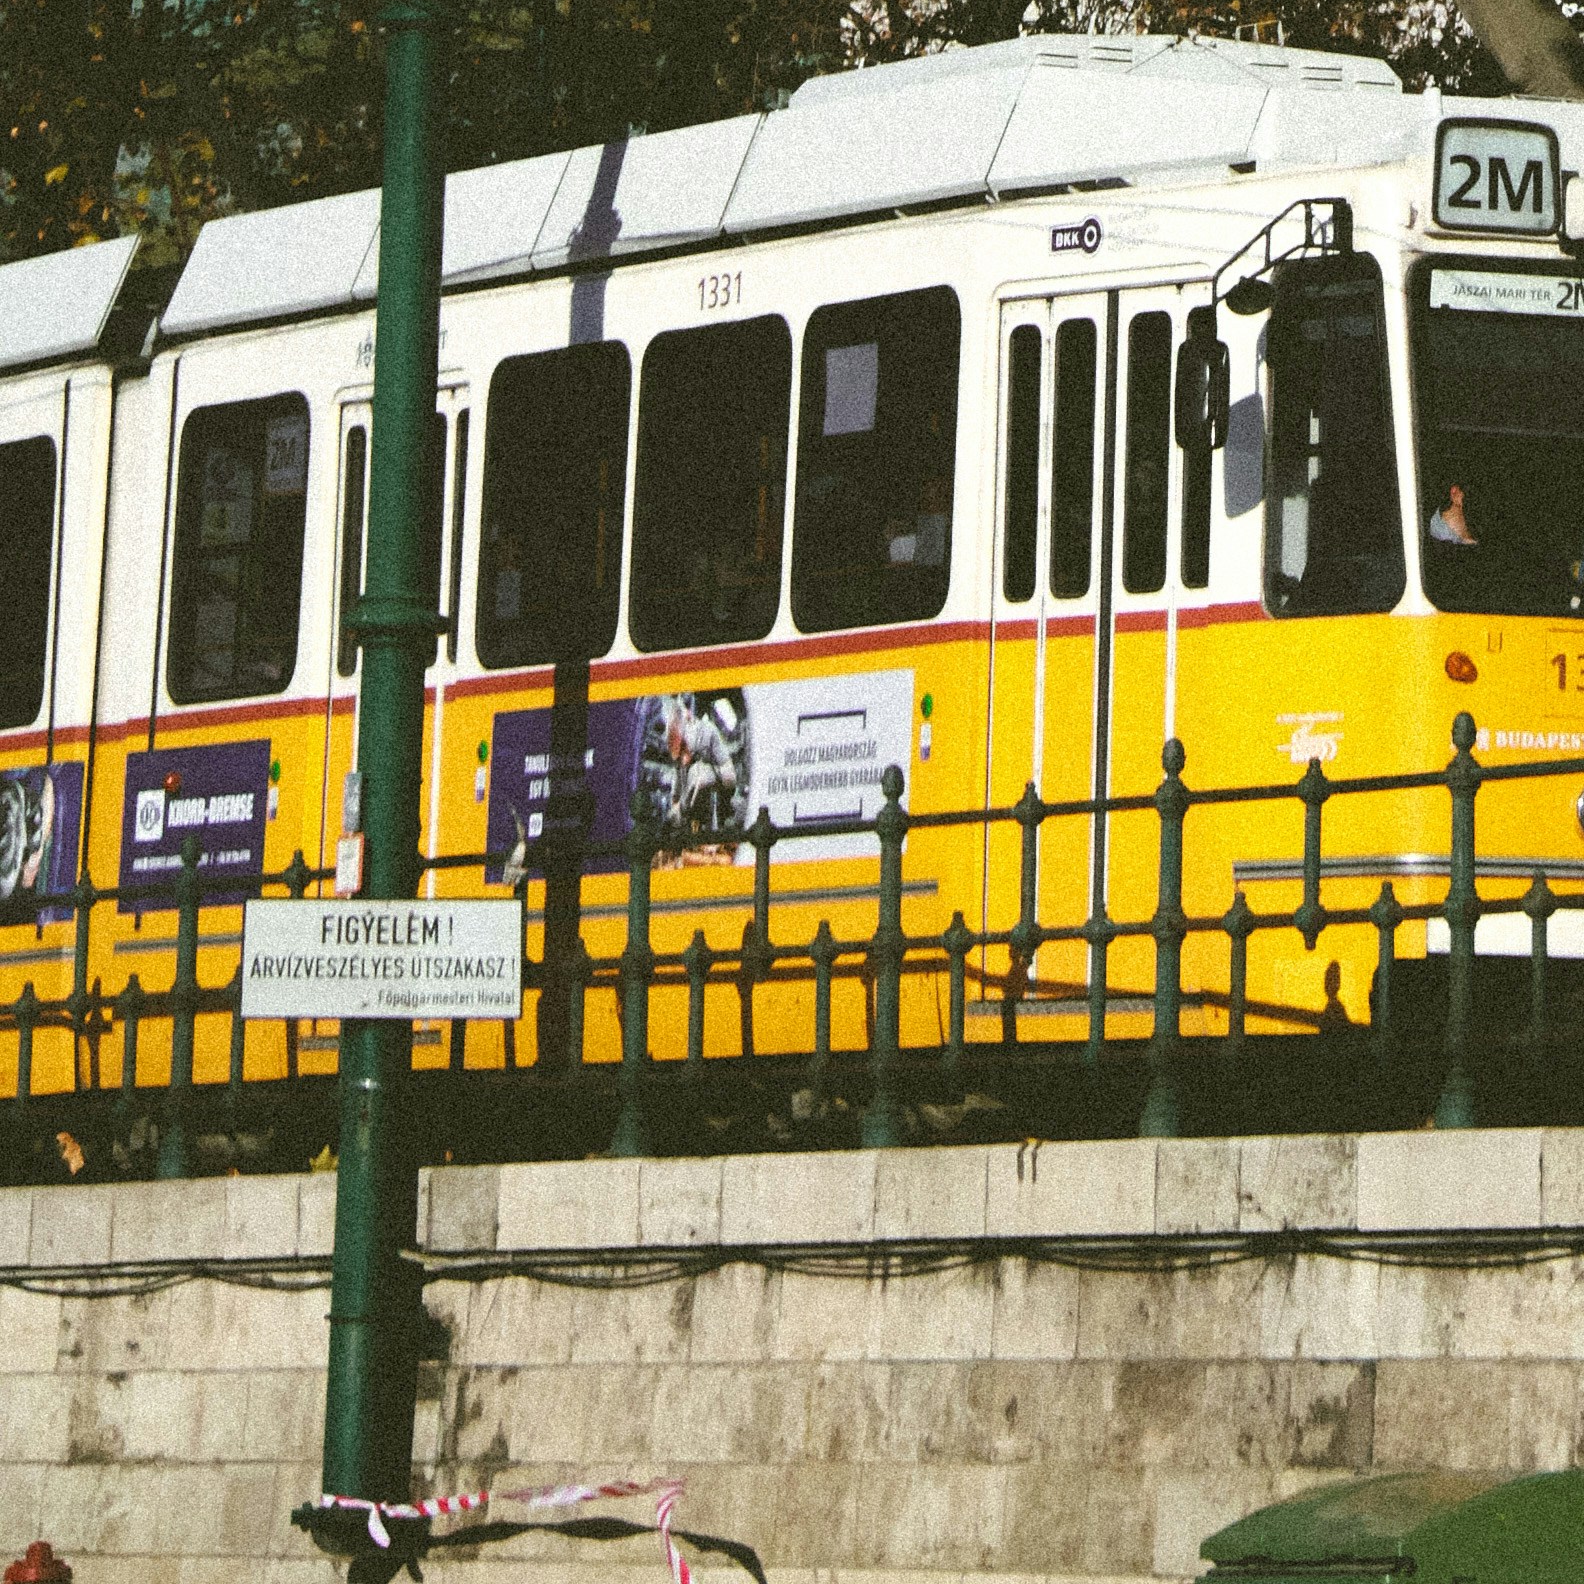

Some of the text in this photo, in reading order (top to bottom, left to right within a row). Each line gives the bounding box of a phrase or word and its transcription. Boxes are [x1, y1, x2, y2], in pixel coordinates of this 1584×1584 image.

[1447, 155, 1545, 214] 2M
[1055, 231, 1080, 248] BKK
[698, 272, 743, 310] 1331
[1495, 287, 1527, 299] MARI
[250, 953, 405, 979] ÁRVÍZVESZÉLYES
[410, 954, 506, 979] ÚTSZAKASZ
